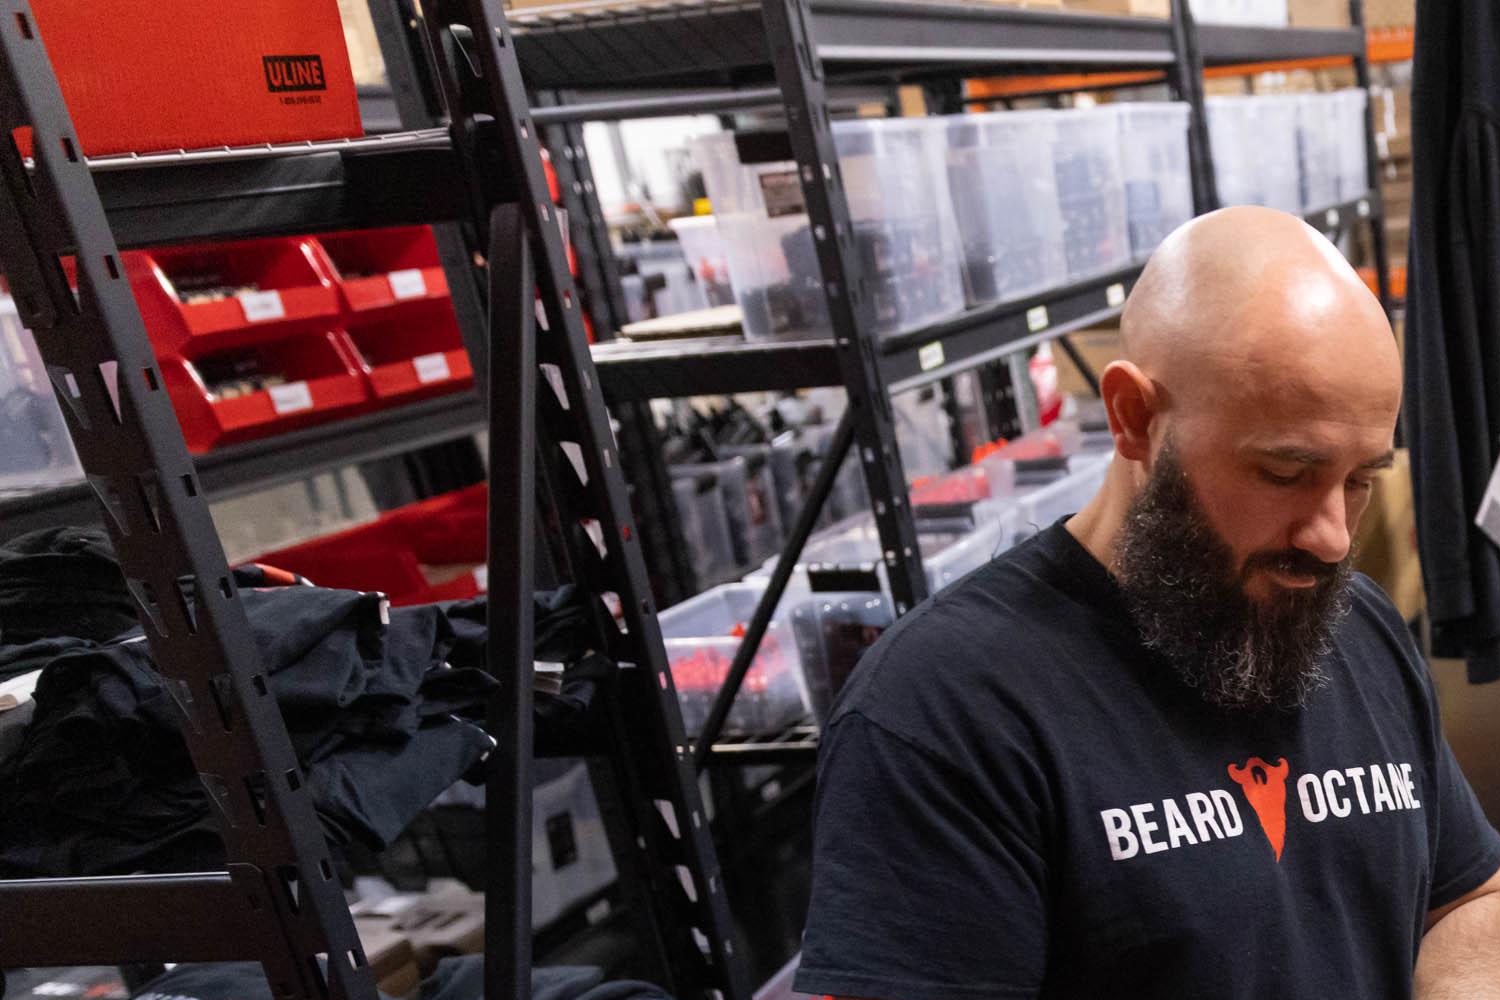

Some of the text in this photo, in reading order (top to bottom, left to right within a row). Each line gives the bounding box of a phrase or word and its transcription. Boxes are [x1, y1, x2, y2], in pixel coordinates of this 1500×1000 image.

[265, 59, 323, 88] ULINE
[1101, 763, 1421, 861] BEARD OCTANE
